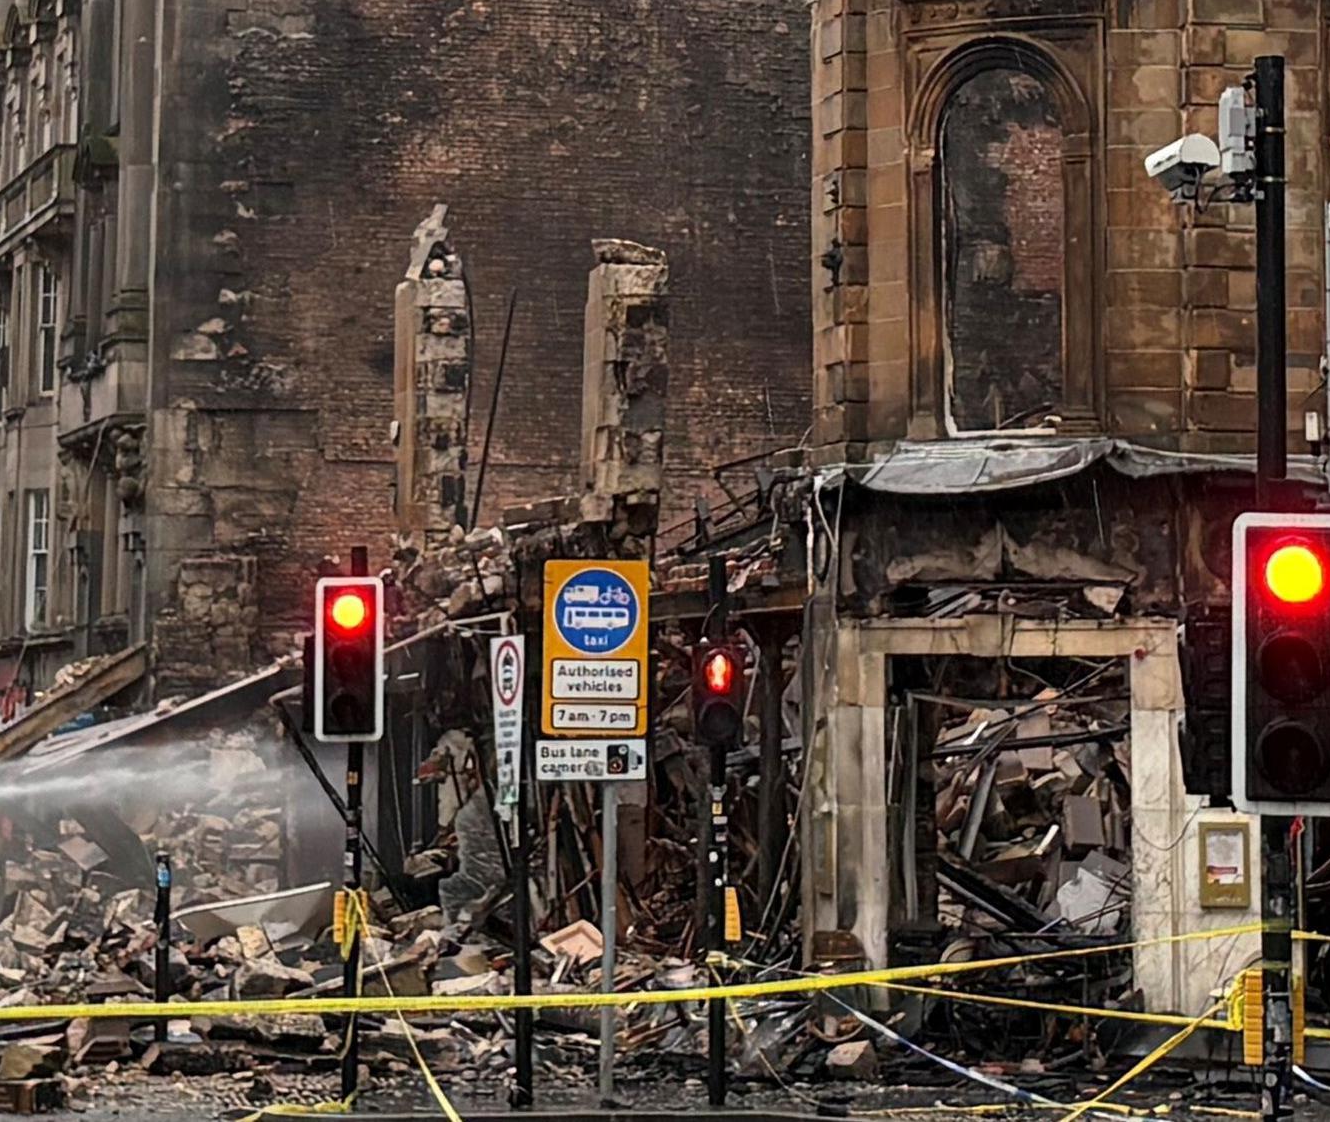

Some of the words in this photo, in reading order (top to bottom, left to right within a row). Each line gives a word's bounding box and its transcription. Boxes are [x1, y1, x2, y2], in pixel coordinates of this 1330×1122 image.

[584, 634, 608, 647] taxi
[557, 665, 633, 678] Authorised
[567, 681, 623, 693] vehicles
[557, 710, 566, 722] 7
[599, 710, 608, 722] 7
[541, 746, 566, 758] Bus
[570, 746, 600, 758] lane
